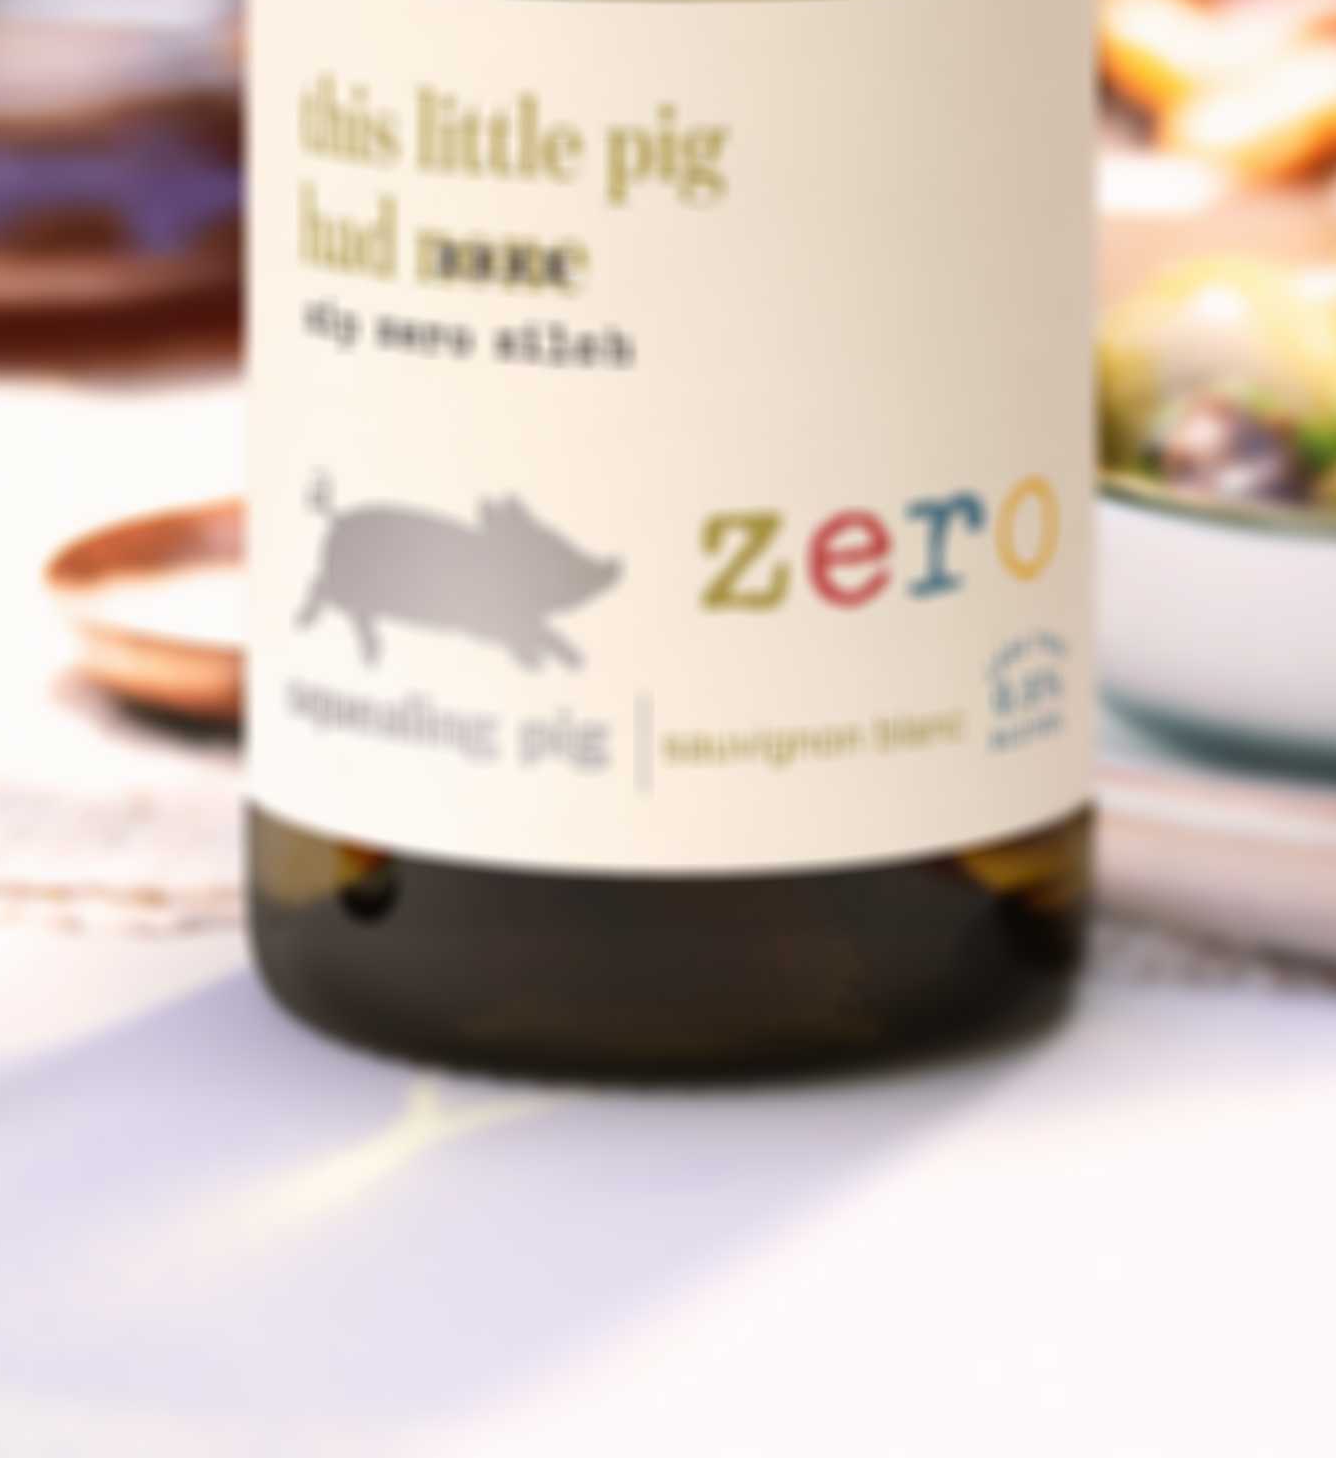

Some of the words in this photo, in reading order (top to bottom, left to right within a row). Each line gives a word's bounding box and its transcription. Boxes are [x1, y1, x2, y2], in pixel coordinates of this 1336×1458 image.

[298, 73, 402, 167] this
[415, 85, 583, 183] little
[606, 103, 729, 208] pig
[298, 182, 398, 281] had
[698, 475, 1060, 614] zero
[517, 708, 614, 775] pig
[660, 724, 860, 771] sauvignon
